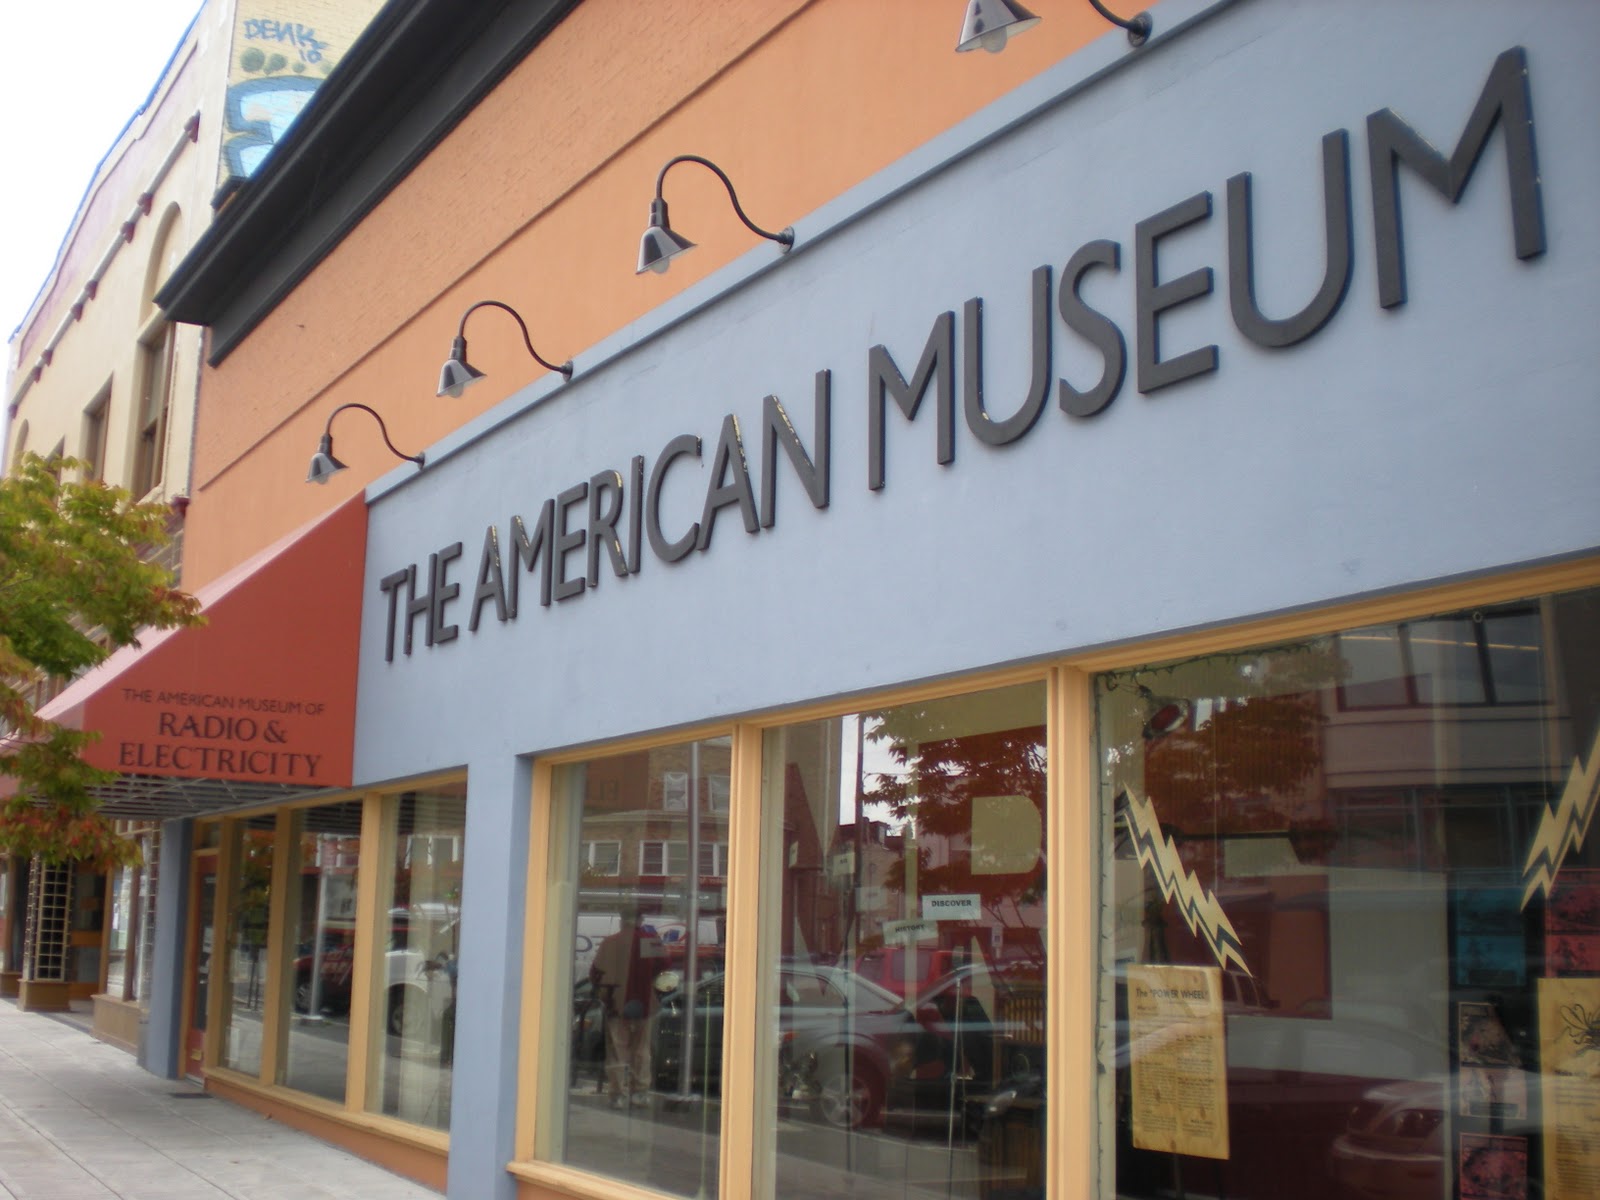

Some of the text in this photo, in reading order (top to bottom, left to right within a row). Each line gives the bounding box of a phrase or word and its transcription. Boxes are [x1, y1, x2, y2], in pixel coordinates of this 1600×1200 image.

[380, 45, 1547, 663] THE AMERICAN MUSEUM
[123, 688, 325, 716] THE AMERICAN MUSEUM OF
[158, 711, 288, 744] RADIO &
[118, 741, 322, 778] ELECTRICITY
[931, 900, 972, 908] DISCOVER
[895, 924, 925, 933] HISTORY
[1136, 988, 1148, 998] The
